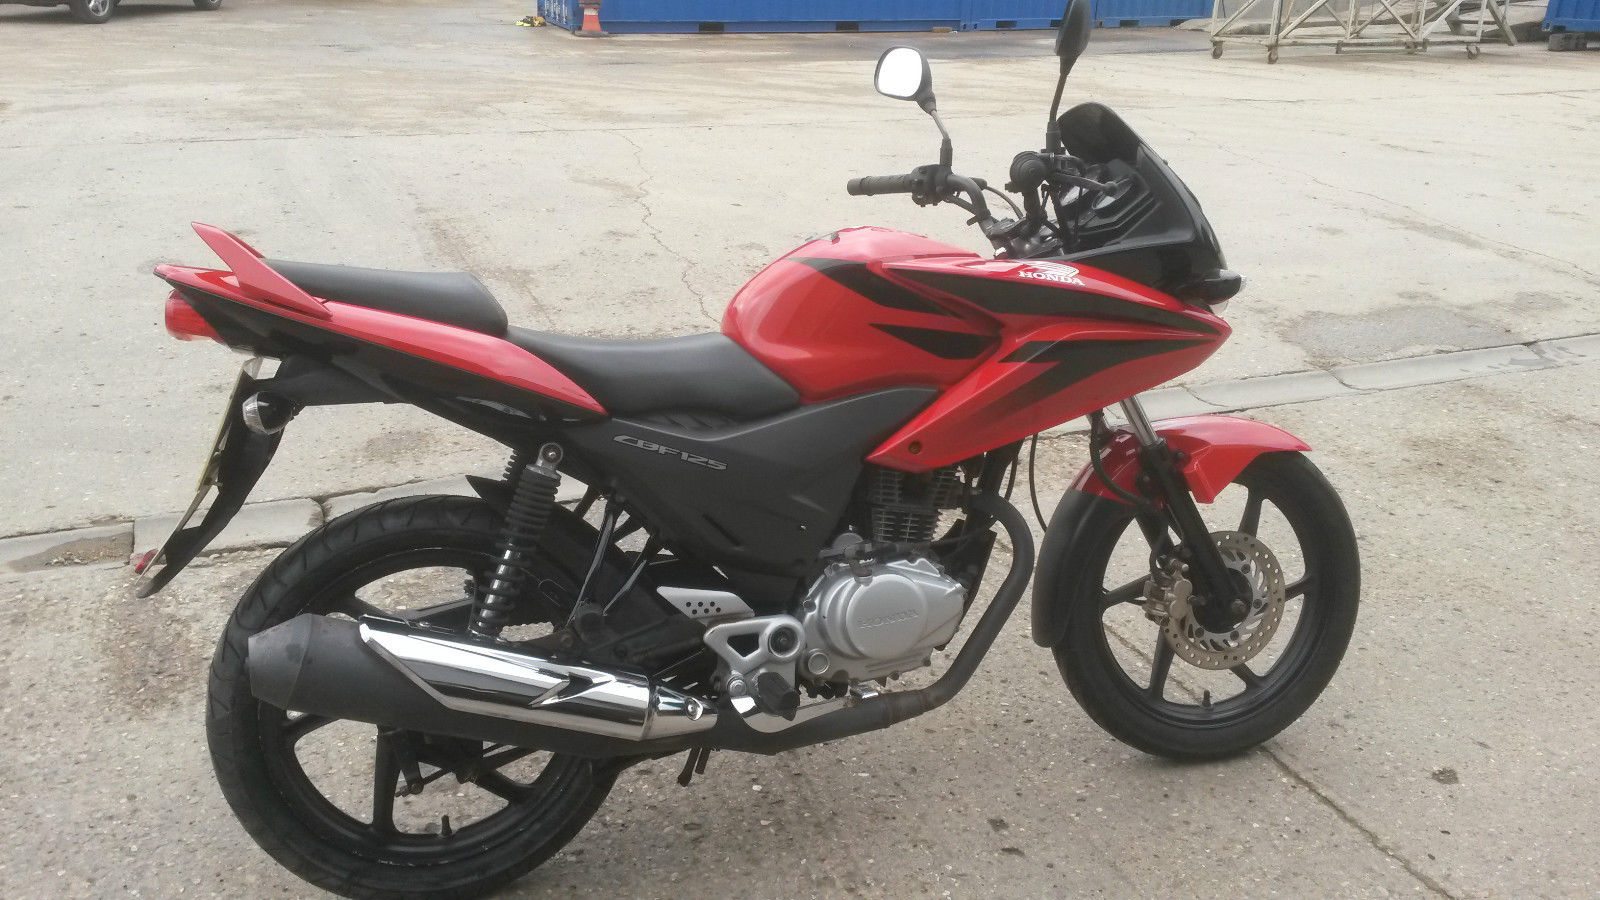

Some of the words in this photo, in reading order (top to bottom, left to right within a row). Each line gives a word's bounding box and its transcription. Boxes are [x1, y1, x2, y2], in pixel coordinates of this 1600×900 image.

[1018, 270, 1086, 286] HONDA
[613, 435, 728, 470] CBF125
[858, 608, 919, 630] HONDA
